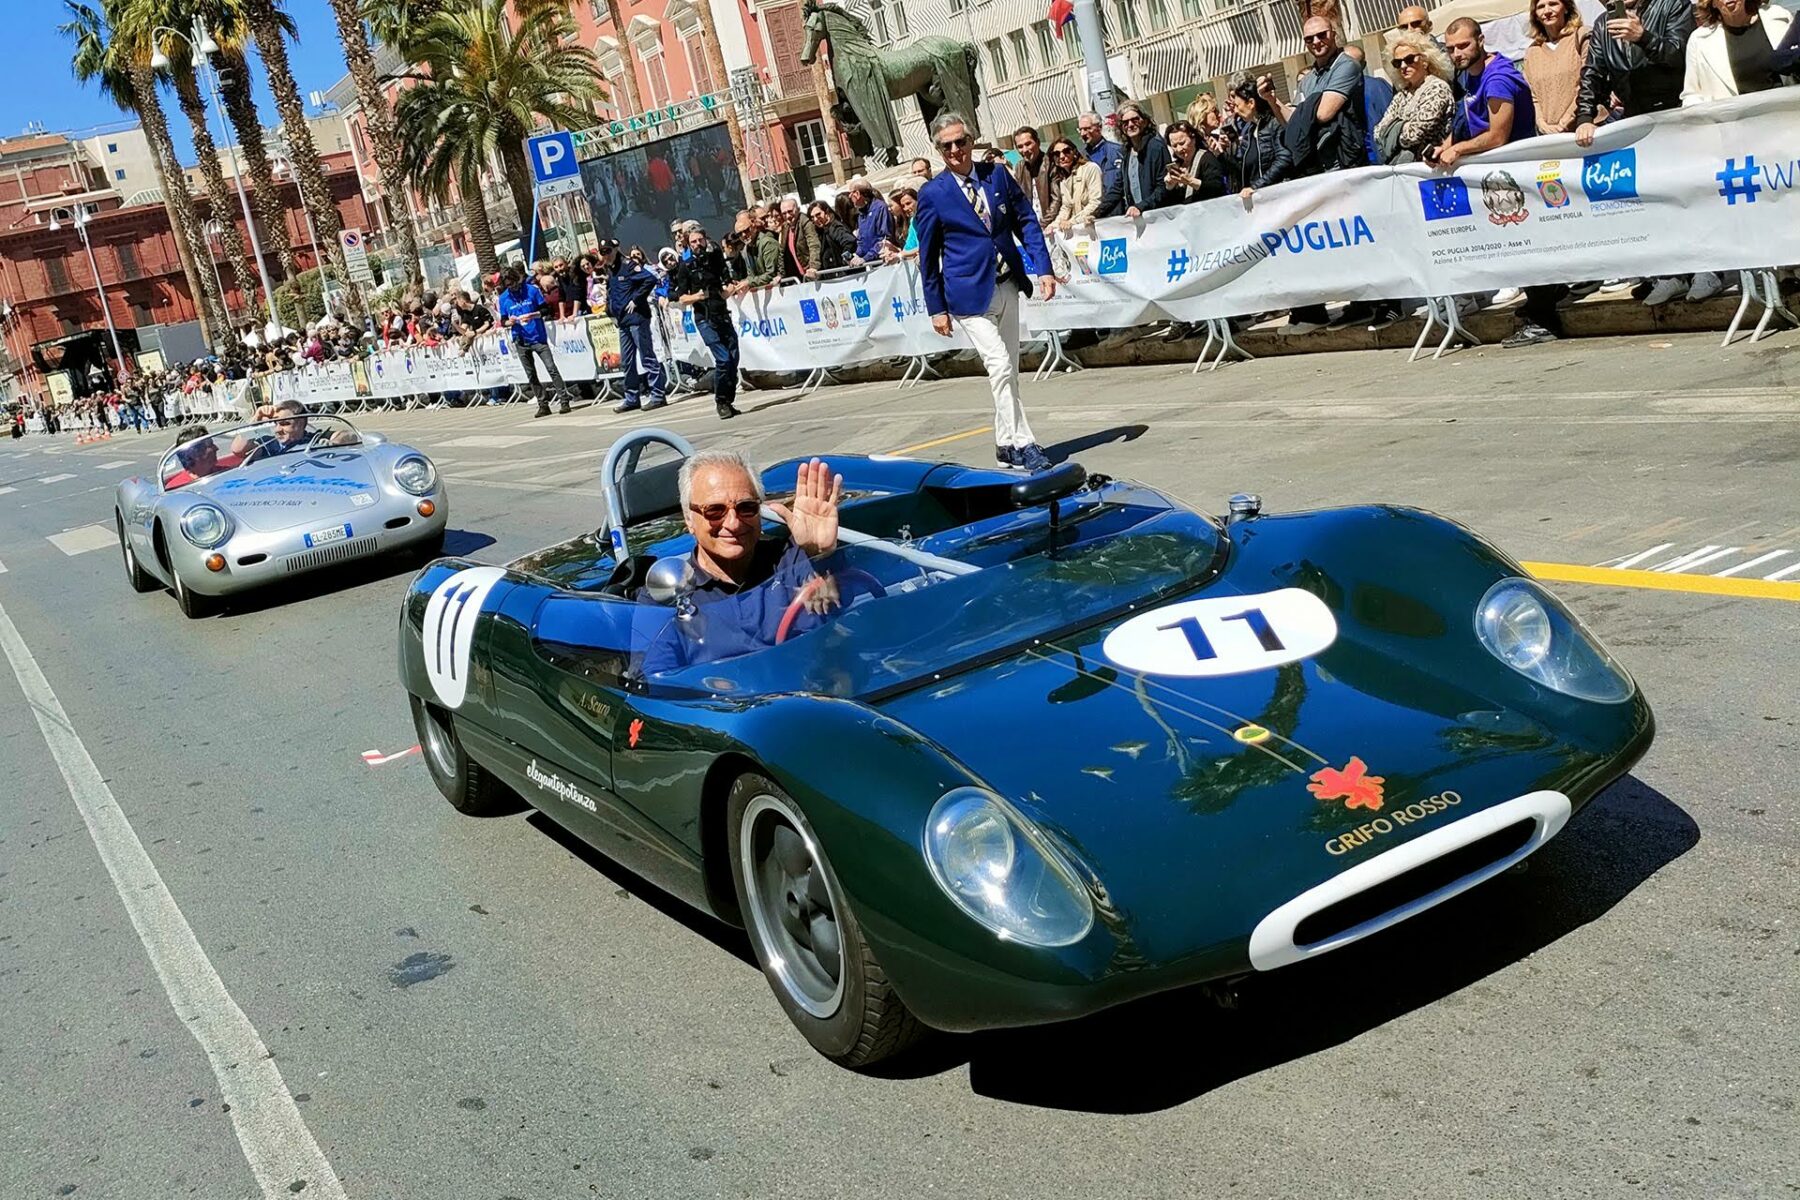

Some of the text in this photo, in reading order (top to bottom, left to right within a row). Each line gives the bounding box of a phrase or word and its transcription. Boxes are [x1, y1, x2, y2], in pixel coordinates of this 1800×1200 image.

[538, 140, 565, 175] P
[1586, 161, 1632, 195] Puglia
[1715, 154, 1800, 205] #W
[1427, 225, 1477, 237] UNIONE EUROPEA
[1563, 211, 1583, 219] PUGLIA
[1166, 215, 1375, 283] #WEAREINPUGLIA
[1432, 249, 1446, 257] POC
[1447, 246, 1470, 255] PUGLIA
[1471, 242, 1502, 252] 2014/2020
[1543, 243, 1574, 253] competitivo
[1574, 240, 1586, 249] delle
[436, 581, 478, 681] 11
[1156, 607, 1286, 661] 11
[526, 758, 598, 812] elegantepotenza
[1325, 790, 1462, 856] GRIFO ROSSO
